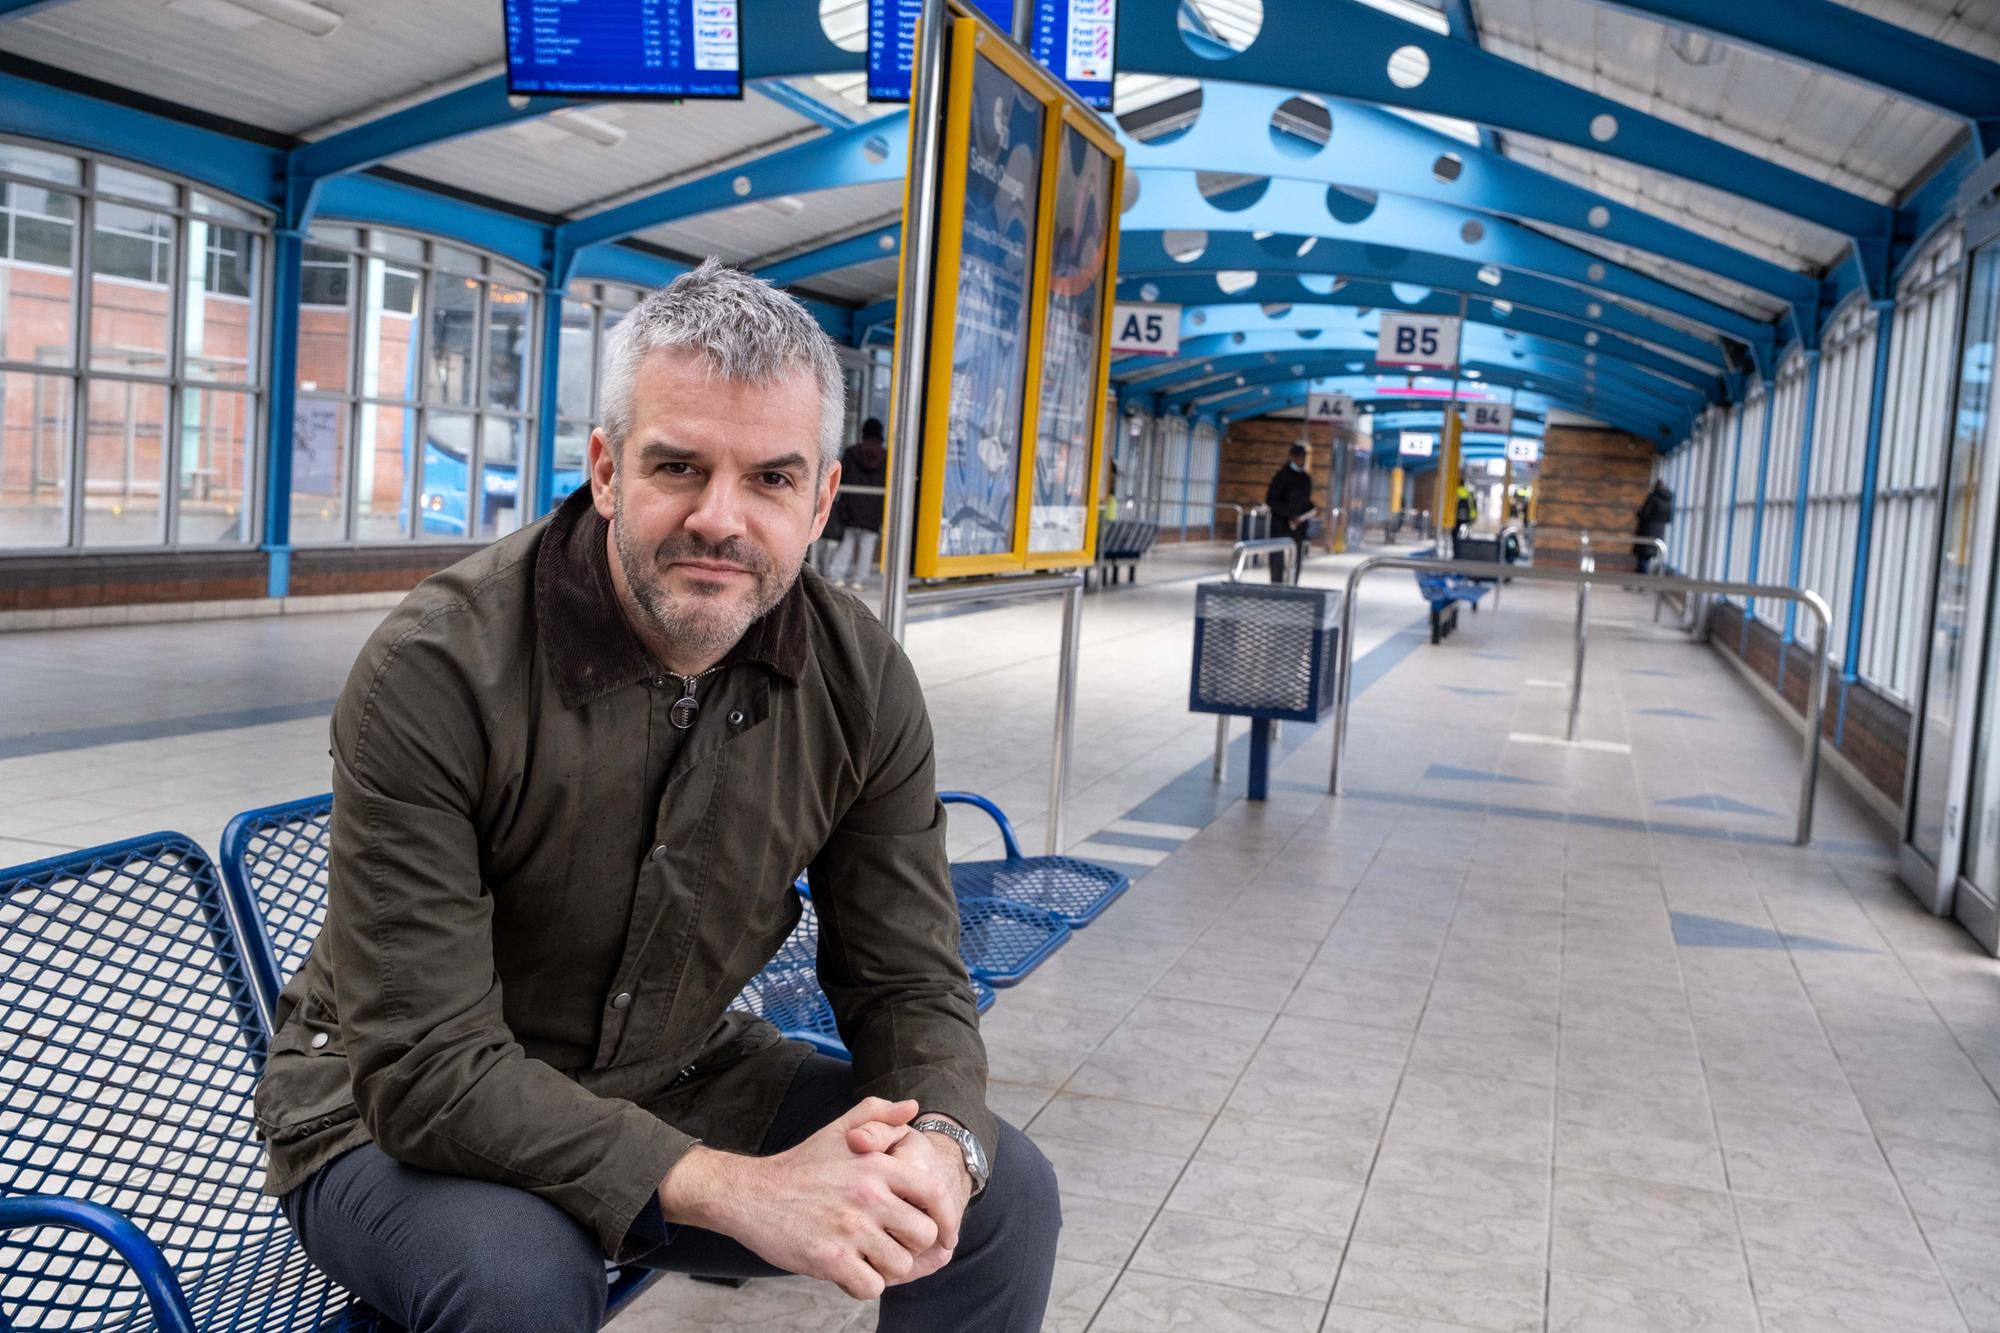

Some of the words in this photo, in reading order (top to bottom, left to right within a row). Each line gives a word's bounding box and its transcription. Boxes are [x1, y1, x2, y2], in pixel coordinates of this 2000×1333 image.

[1120, 313, 1163, 343] A5
[1395, 326, 1438, 357] B5
[1317, 402, 1343, 416] A4
[1474, 407, 1500, 424] B4
